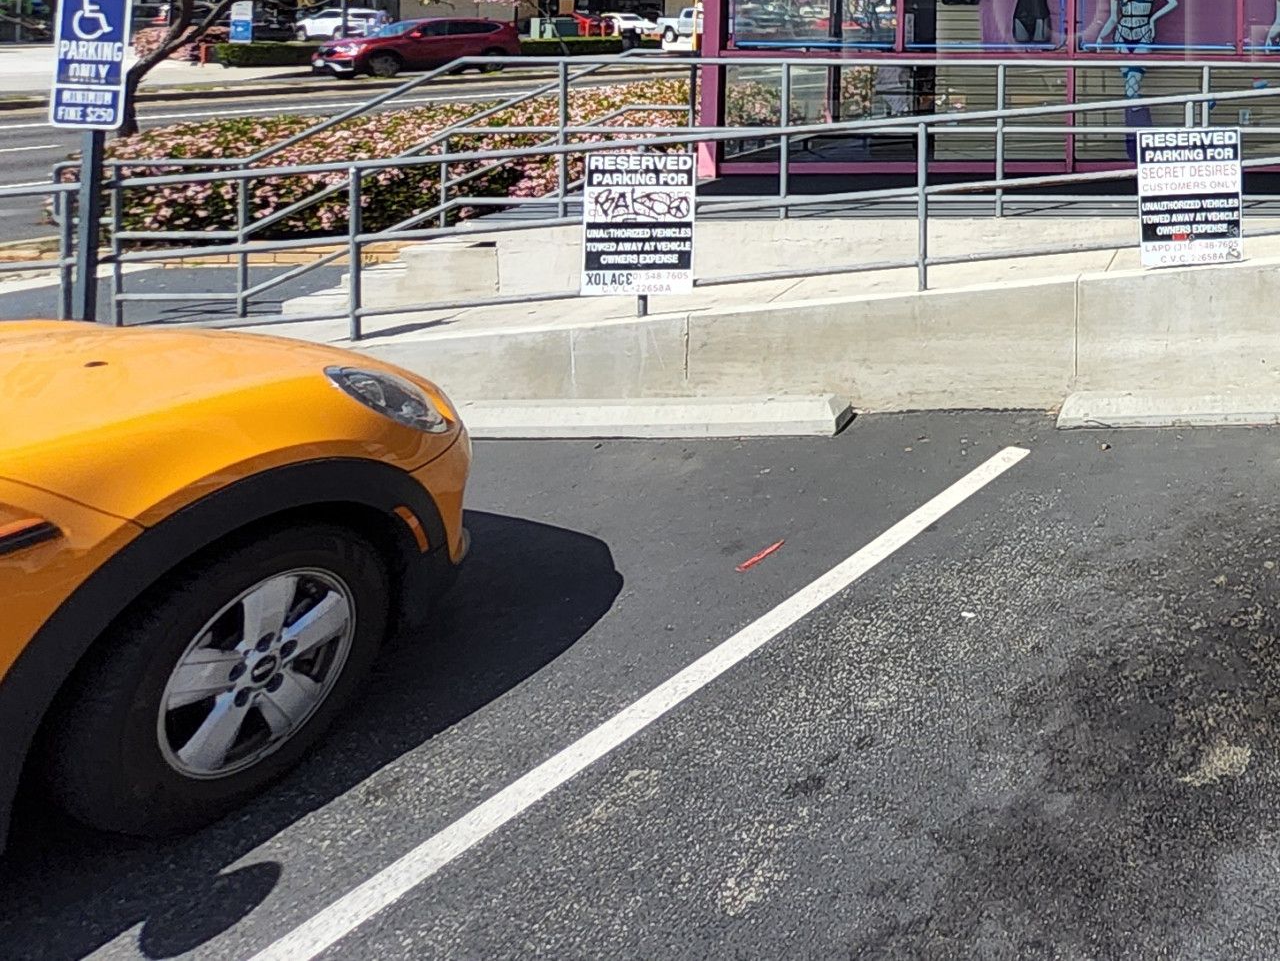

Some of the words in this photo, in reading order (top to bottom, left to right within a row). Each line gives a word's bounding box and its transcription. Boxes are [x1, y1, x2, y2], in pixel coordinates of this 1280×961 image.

[60, 40, 123, 61] PARKING
[68, 63, 111, 83] ONLY
[57, 106, 84, 120] FINE
[85, 107, 114, 122] $250
[1141, 132, 1237, 147] RESERVED
[1145, 149, 1204, 162] PARKING
[1206, 148, 1234, 160] FOR
[589, 156, 692, 170] RESERVED
[1141, 166, 1186, 179] SECRET
[1189, 164, 1237, 177] DESIRES
[592, 173, 656, 185] PARKING
[659, 173, 688, 185] FOR
[1142, 181, 1207, 192] CUSTOMERS
[1209, 180, 1237, 189] ONLY
[1141, 199, 1201, 211] UNAUTHORIZED
[1201, 198, 1239, 209] VEHICLES
[1141, 214, 1171, 224] TOWED
[1171, 213, 1194, 223] AWAY
[1195, 212, 1207, 221] AT
[1207, 211, 1239, 221] VEHICLE
[586, 228, 651, 238] UNAUTHORIZED
[652, 228, 691, 237] VEHICLES
[1156, 224, 1191, 235] OWNERS
[1192, 223, 1228, 233] EXPENSE
[586, 242, 616, 251] TOWED
[617, 242, 642, 251] AWAY
[643, 242, 655, 250] AT
[657, 241, 691, 251] VEHICLE
[1145, 244, 1171, 252] LAPD
[600, 254, 638, 264] OWNERS
[639, 253, 679, 263] EXPENSE
